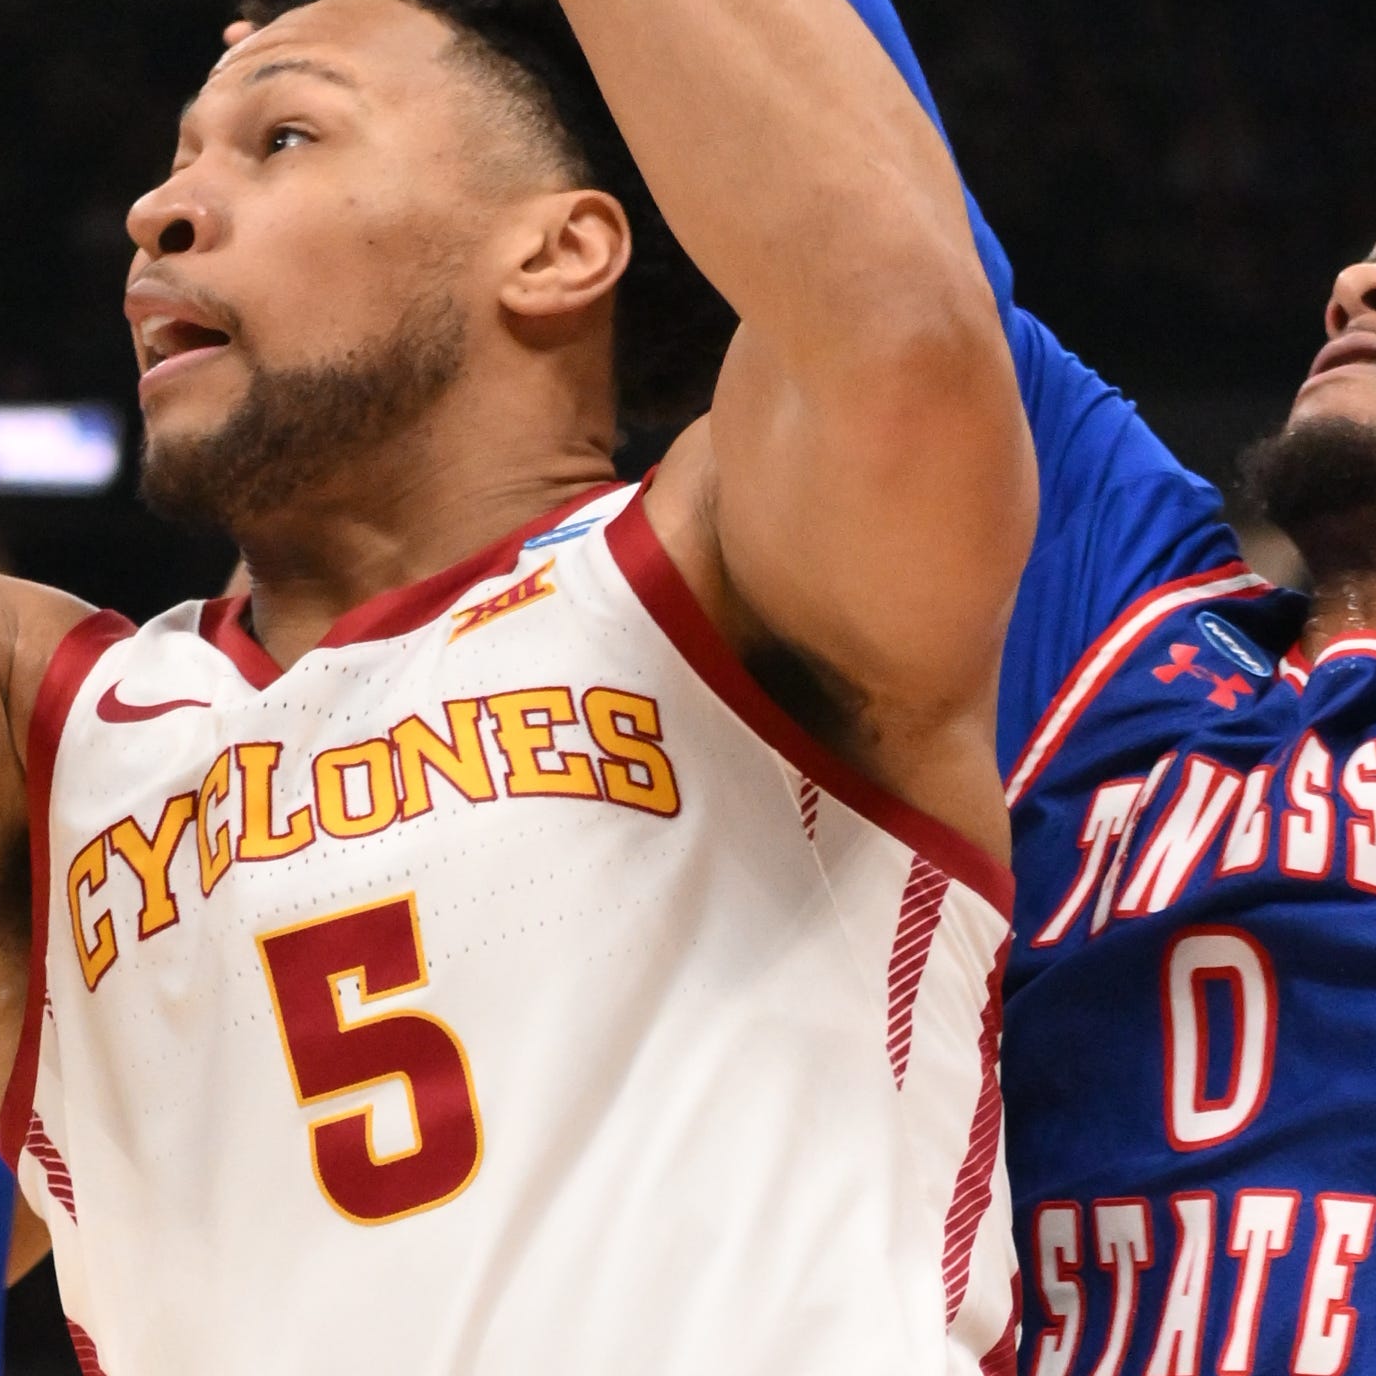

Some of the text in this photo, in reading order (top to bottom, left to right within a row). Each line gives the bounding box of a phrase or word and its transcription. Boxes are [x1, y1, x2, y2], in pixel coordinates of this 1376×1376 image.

[67, 685, 682, 993] CYCLONES
[255, 890, 485, 1227] 5
[1161, 924, 1279, 1151] 0
